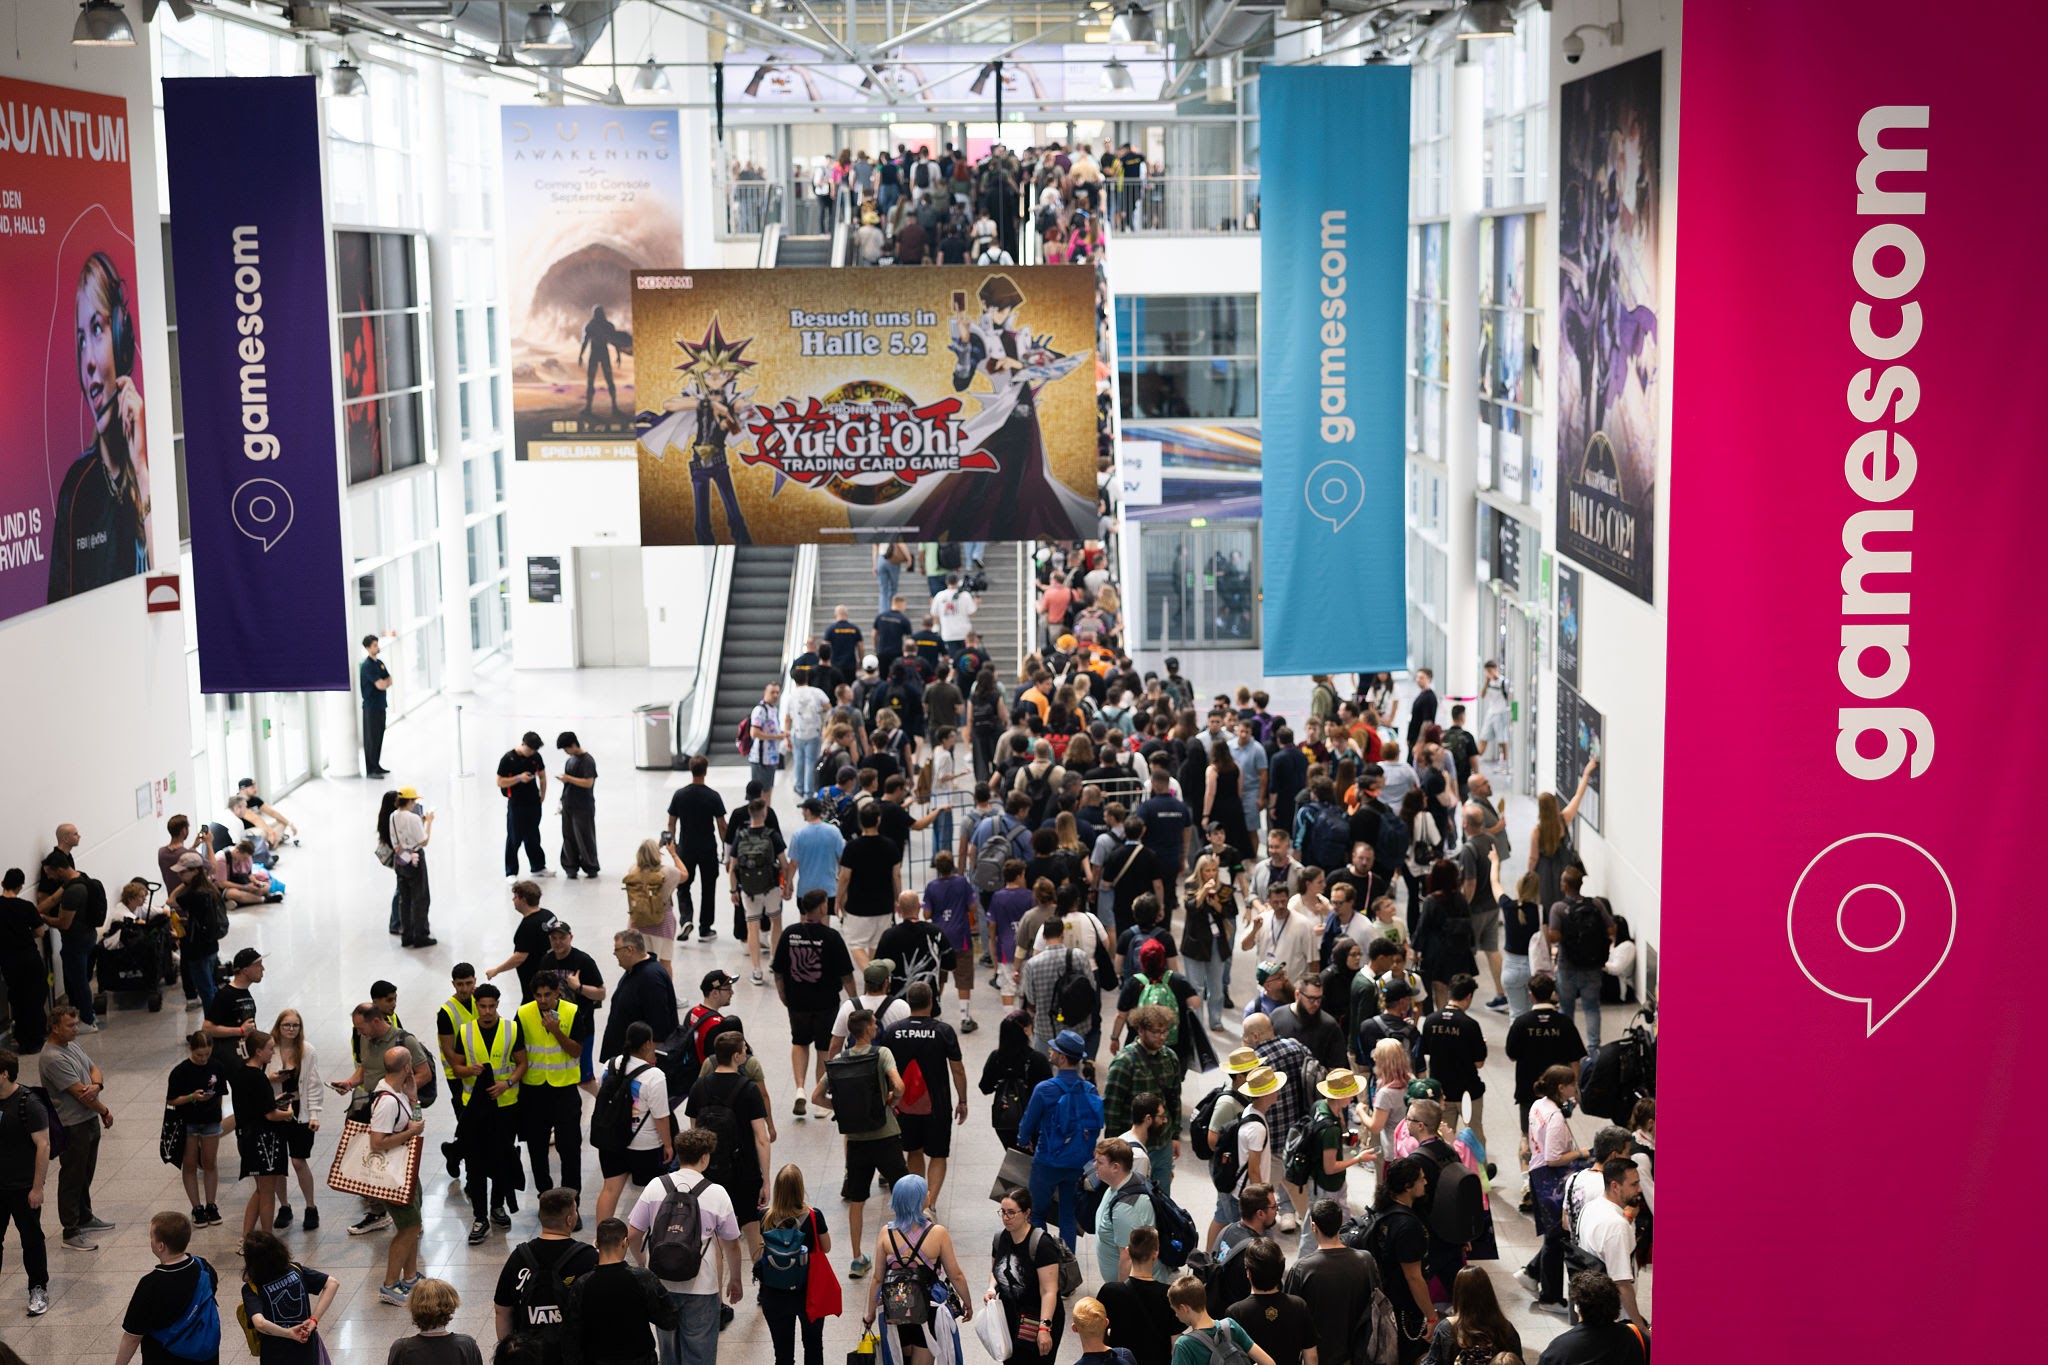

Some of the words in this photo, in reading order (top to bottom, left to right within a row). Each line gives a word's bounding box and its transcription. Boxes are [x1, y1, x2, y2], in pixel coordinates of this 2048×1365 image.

[512, 121, 669, 143] DUNE
[515, 149, 669, 160] AWAKENING
[534, 178, 581, 191] Coming
[585, 179, 598, 190] to
[601, 178, 651, 190] Console
[3, 190, 22, 210] DEN
[551, 192, 616, 204] September
[622, 192, 636, 202] 22
[14, 215, 38, 235] HALL
[39, 216, 46, 235] 9
[637, 276, 693, 289] KONAMI
[789, 309, 869, 328] Besucht
[874, 311, 911, 327] uns
[916, 309, 937, 327] in
[1320, 210, 1356, 444] gamescom
[232, 225, 281, 462] gamescom
[801, 330, 881, 356] Halle
[889, 331, 928, 355] 5.2
[541, 445, 601, 459] SPIELBAR
[1836, 105, 1936, 781] gamescom
[781, 457, 856, 472] TRADING
[859, 457, 906, 471] CARD
[909, 456, 960, 471] GAME
[29, 508, 41, 534] IS
[908, 1030, 936, 1039] PAULI
[1431, 1025, 1460, 1036] TEAM
[1528, 1028, 1560, 1036] TEAM
[528, 1305, 563, 1325] VANS
